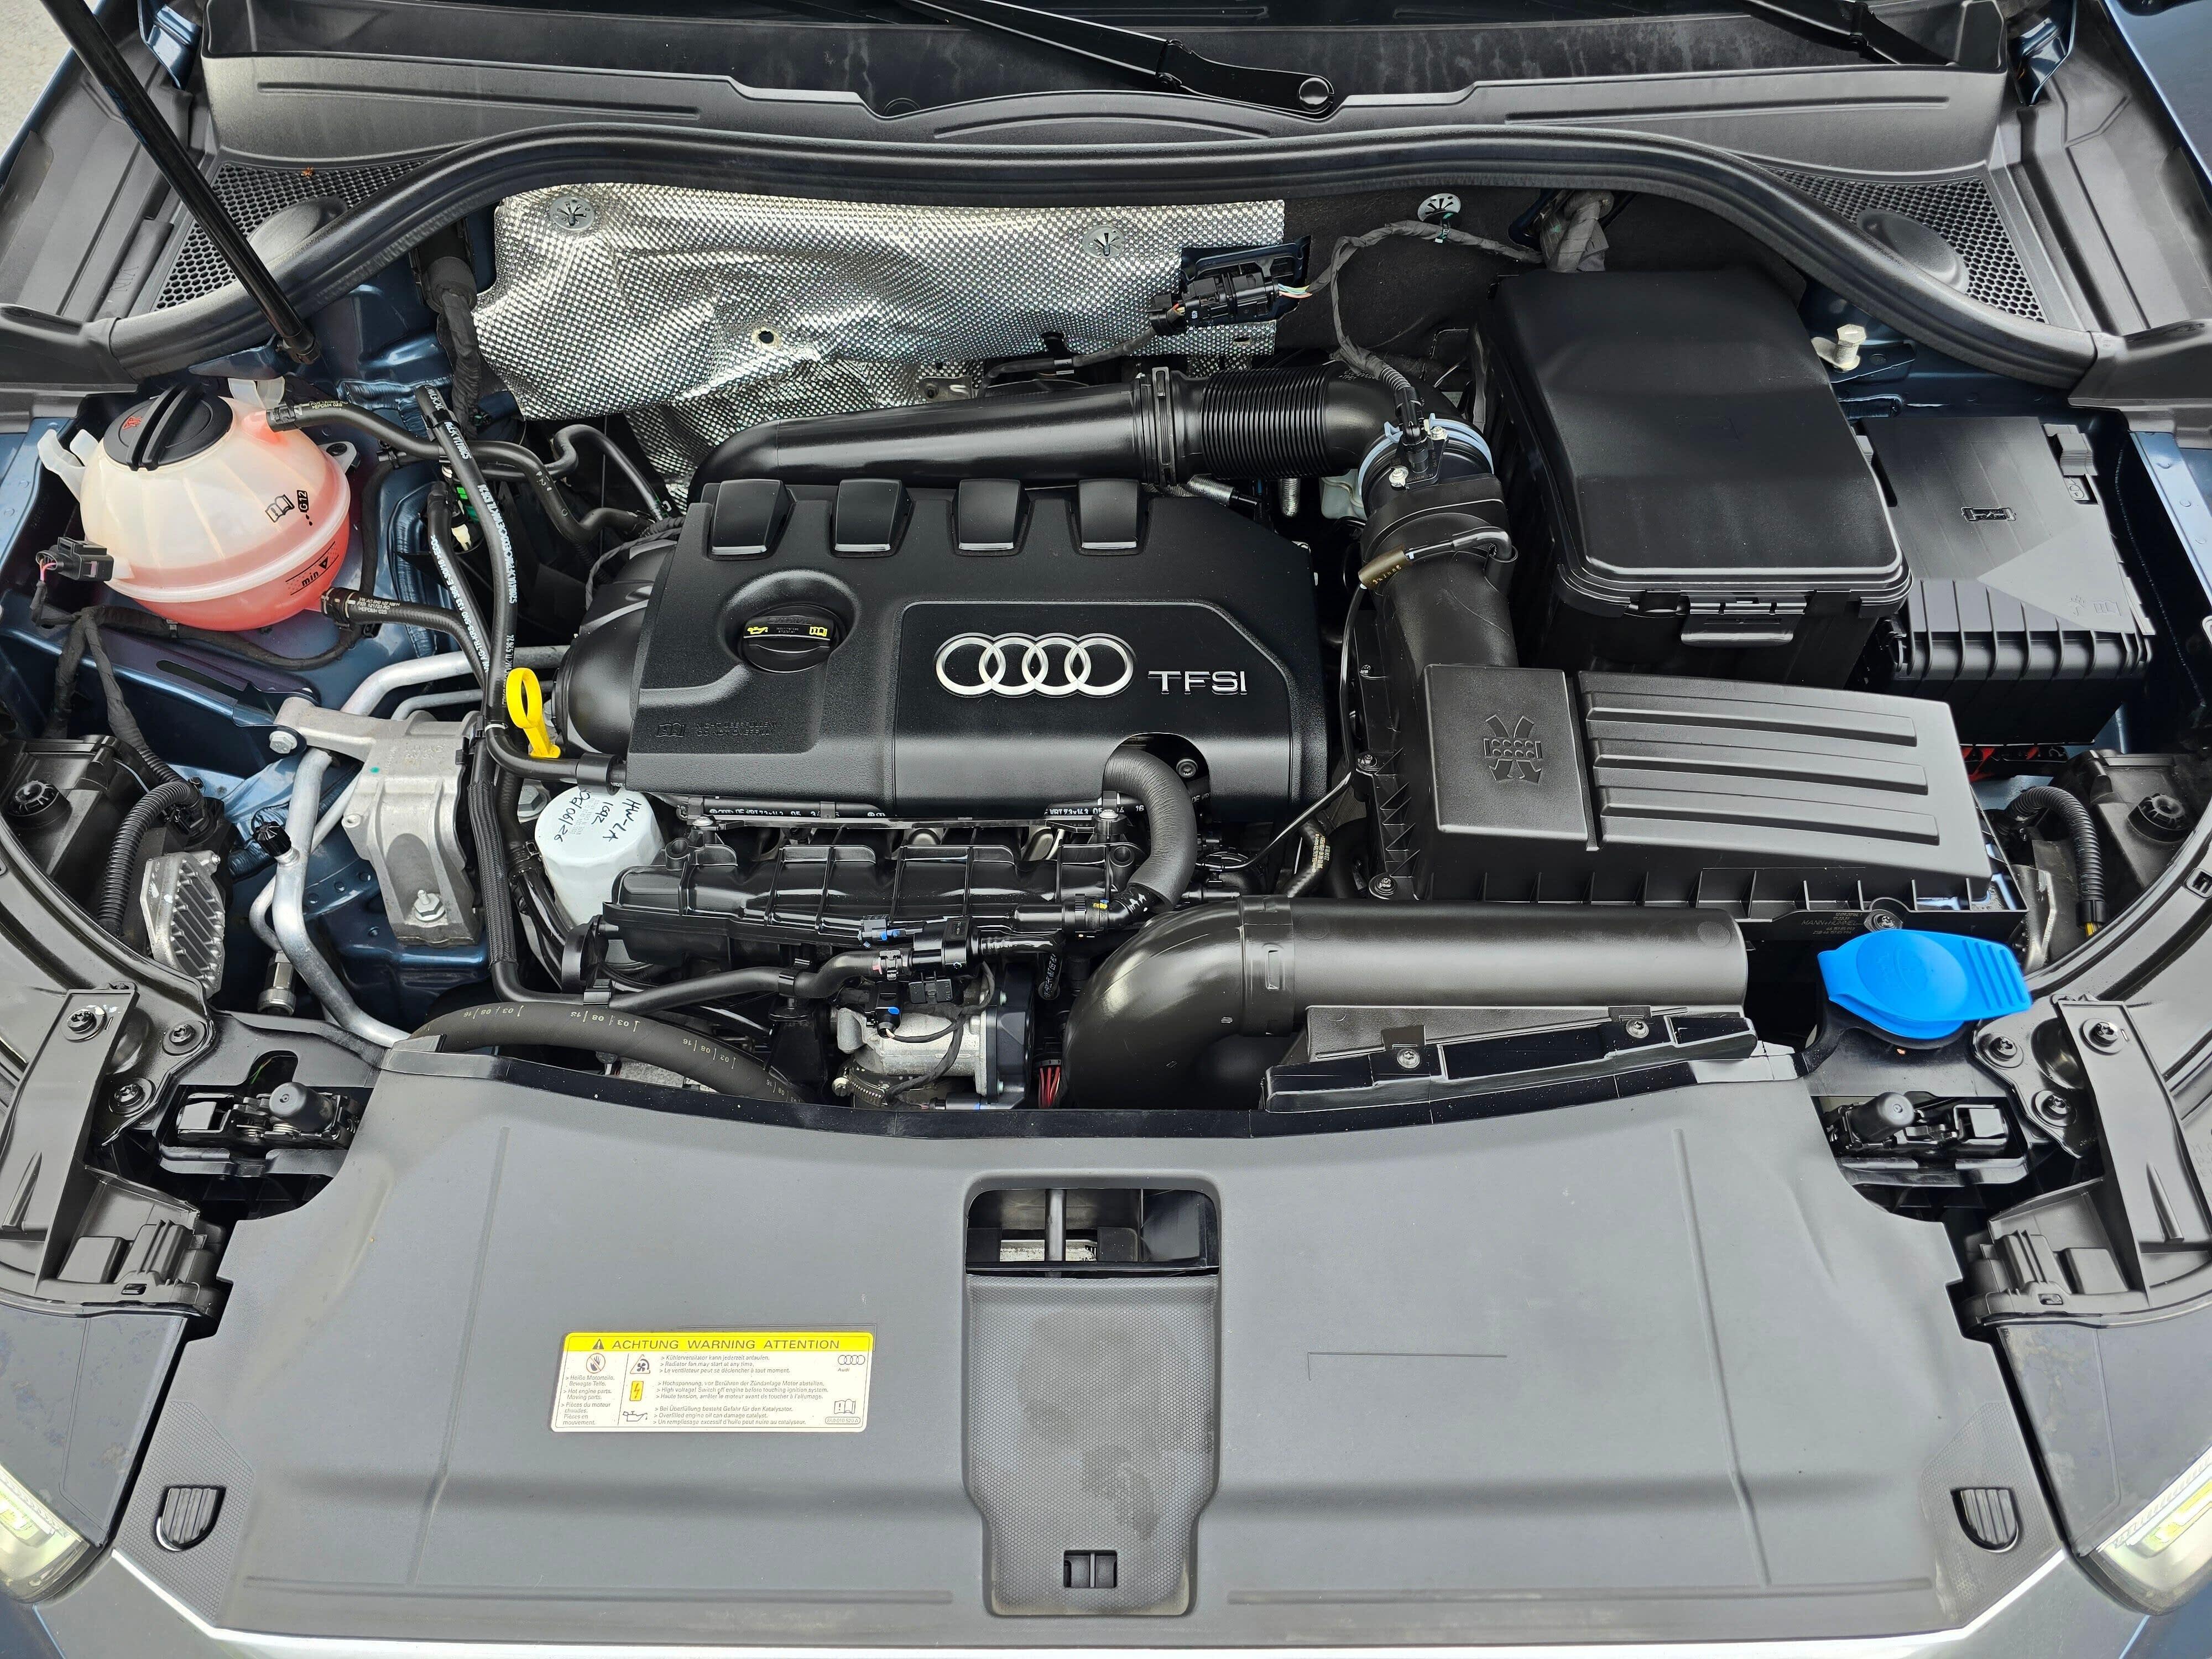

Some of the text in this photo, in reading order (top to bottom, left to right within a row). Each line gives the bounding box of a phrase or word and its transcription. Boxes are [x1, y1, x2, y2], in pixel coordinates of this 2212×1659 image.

[302, 571, 319, 586] min
[1148, 671, 1247, 694] TFSI
[612, 1340, 839, 1349] ACHTUNG WARNING ATTENTION
